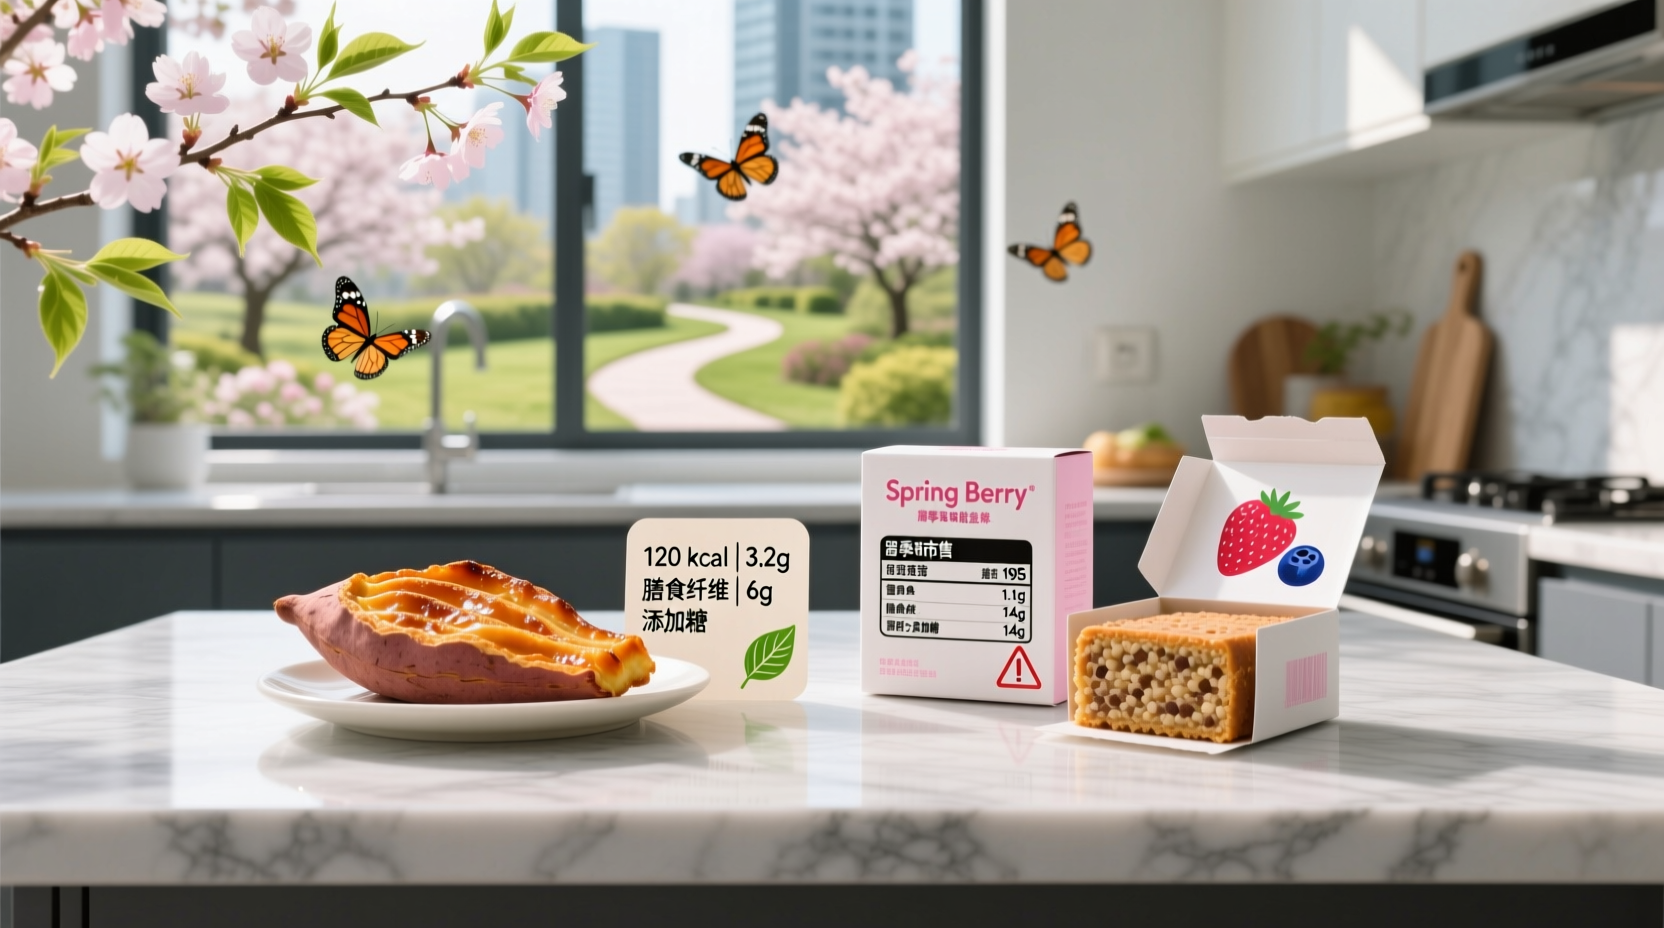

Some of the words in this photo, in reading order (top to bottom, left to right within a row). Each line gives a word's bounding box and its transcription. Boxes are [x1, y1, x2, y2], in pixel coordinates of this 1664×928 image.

[886, 479, 958, 508] Spring
[644, 546, 681, 567] 120
[688, 546, 728, 567] kcal
[746, 546, 790, 573] 3.2g
[1002, 567, 1026, 581] 195
[642, 577, 729, 601] 膳食纤维
[746, 580, 773, 606] 6g
[1002, 589, 1026, 604] 1.1g
[642, 607, 708, 633] 添加糖
[1003, 606, 1026, 622] 14g
[1003, 624, 1025, 639] 14g
